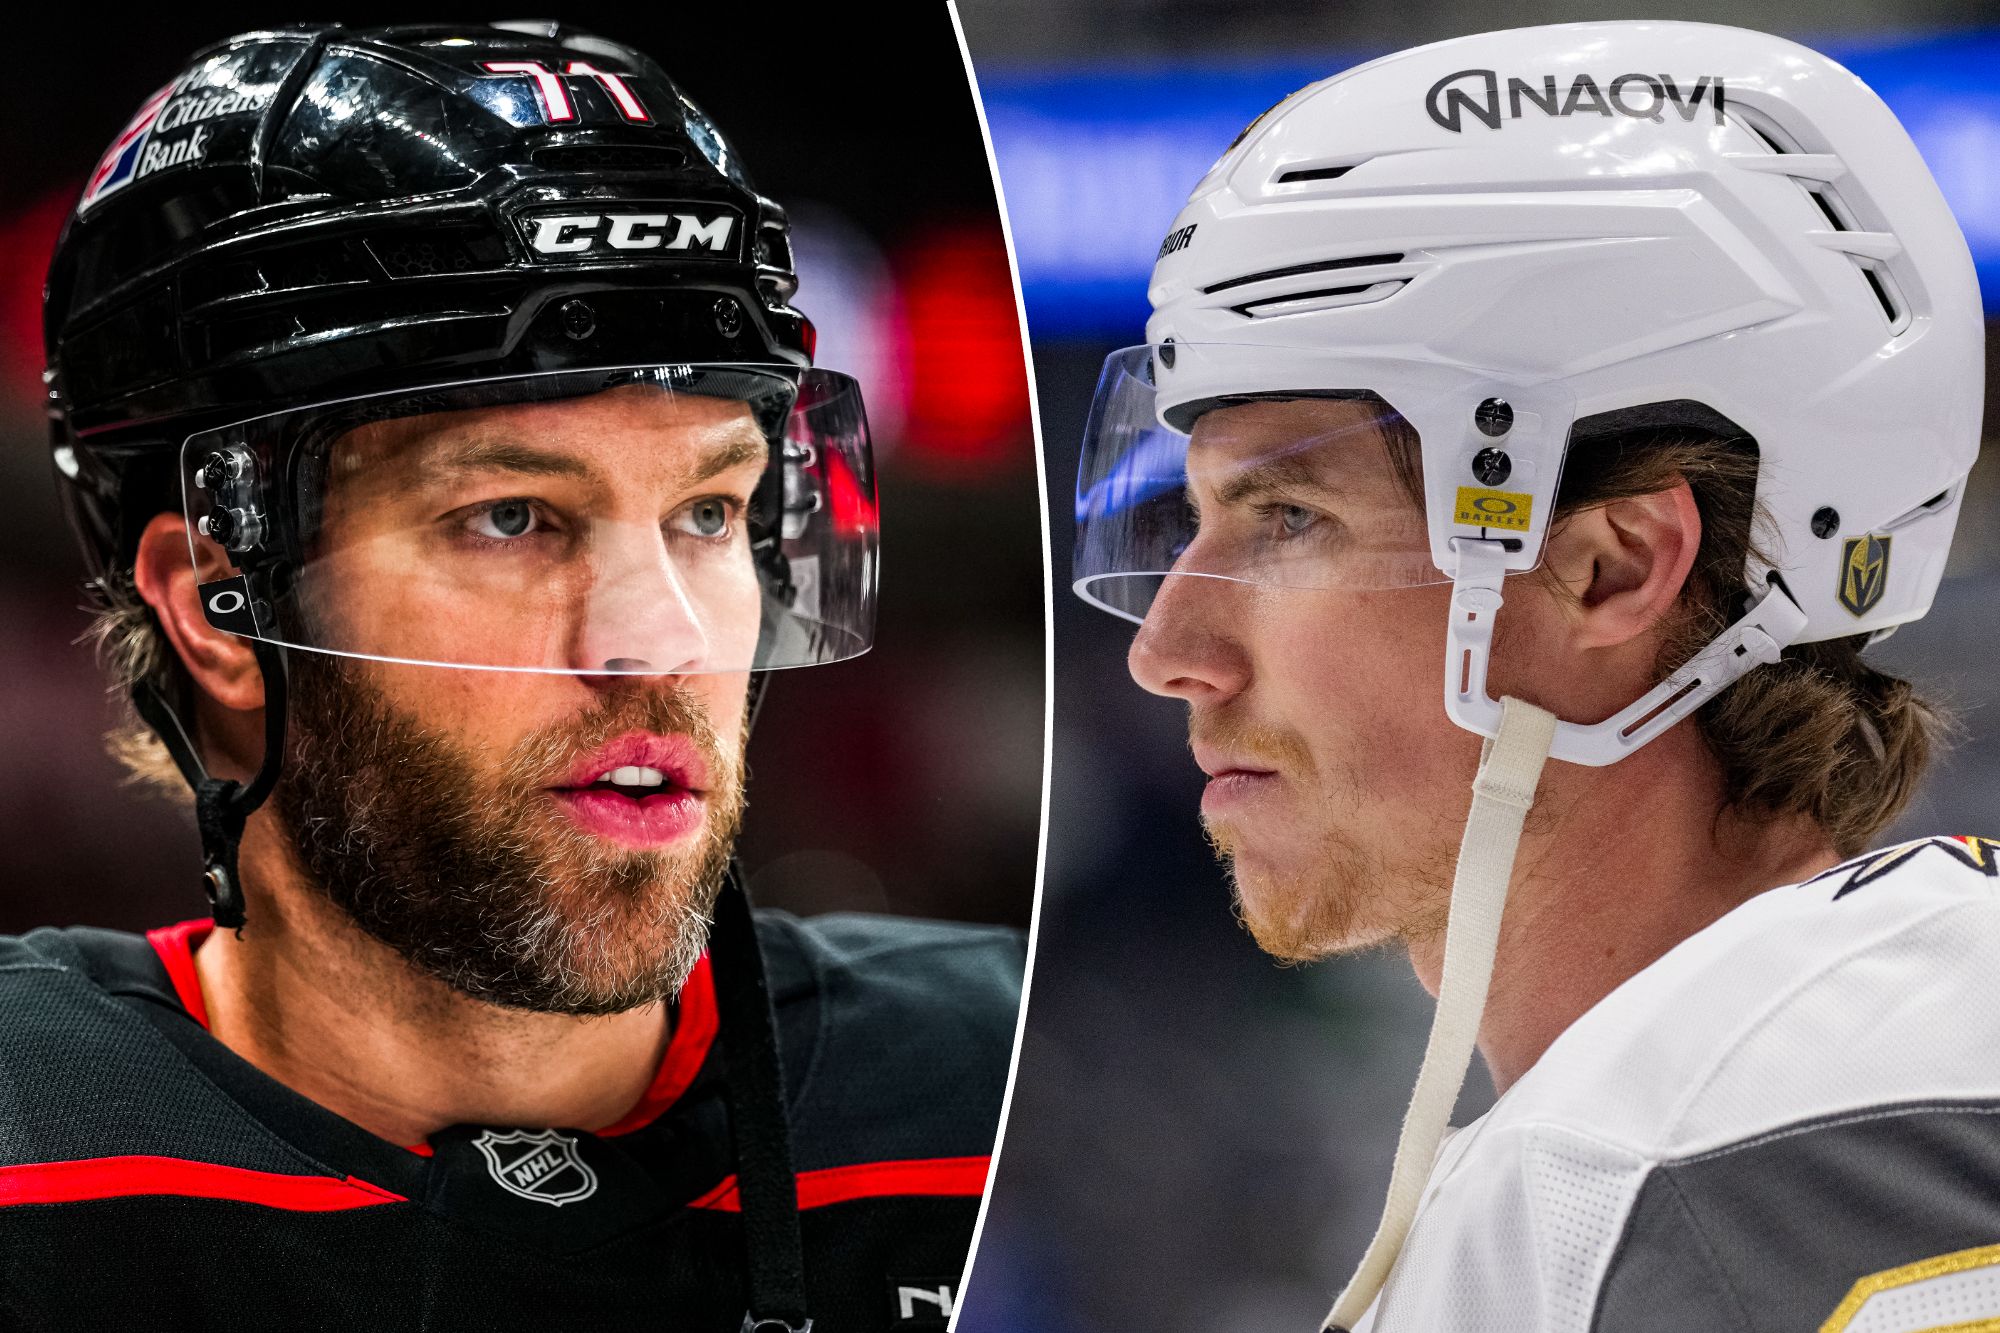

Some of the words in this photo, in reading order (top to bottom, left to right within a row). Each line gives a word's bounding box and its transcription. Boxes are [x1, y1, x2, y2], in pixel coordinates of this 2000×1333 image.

[155, 88, 265, 133] Citizens
[483, 60, 649, 122] 71
[1507, 73, 1726, 126] NAQVI
[136, 125, 208, 179] Bank
[531, 214, 734, 254] CCM
[1461, 511, 1526, 526] OAKLEY
[513, 1150, 563, 1188] NHL
